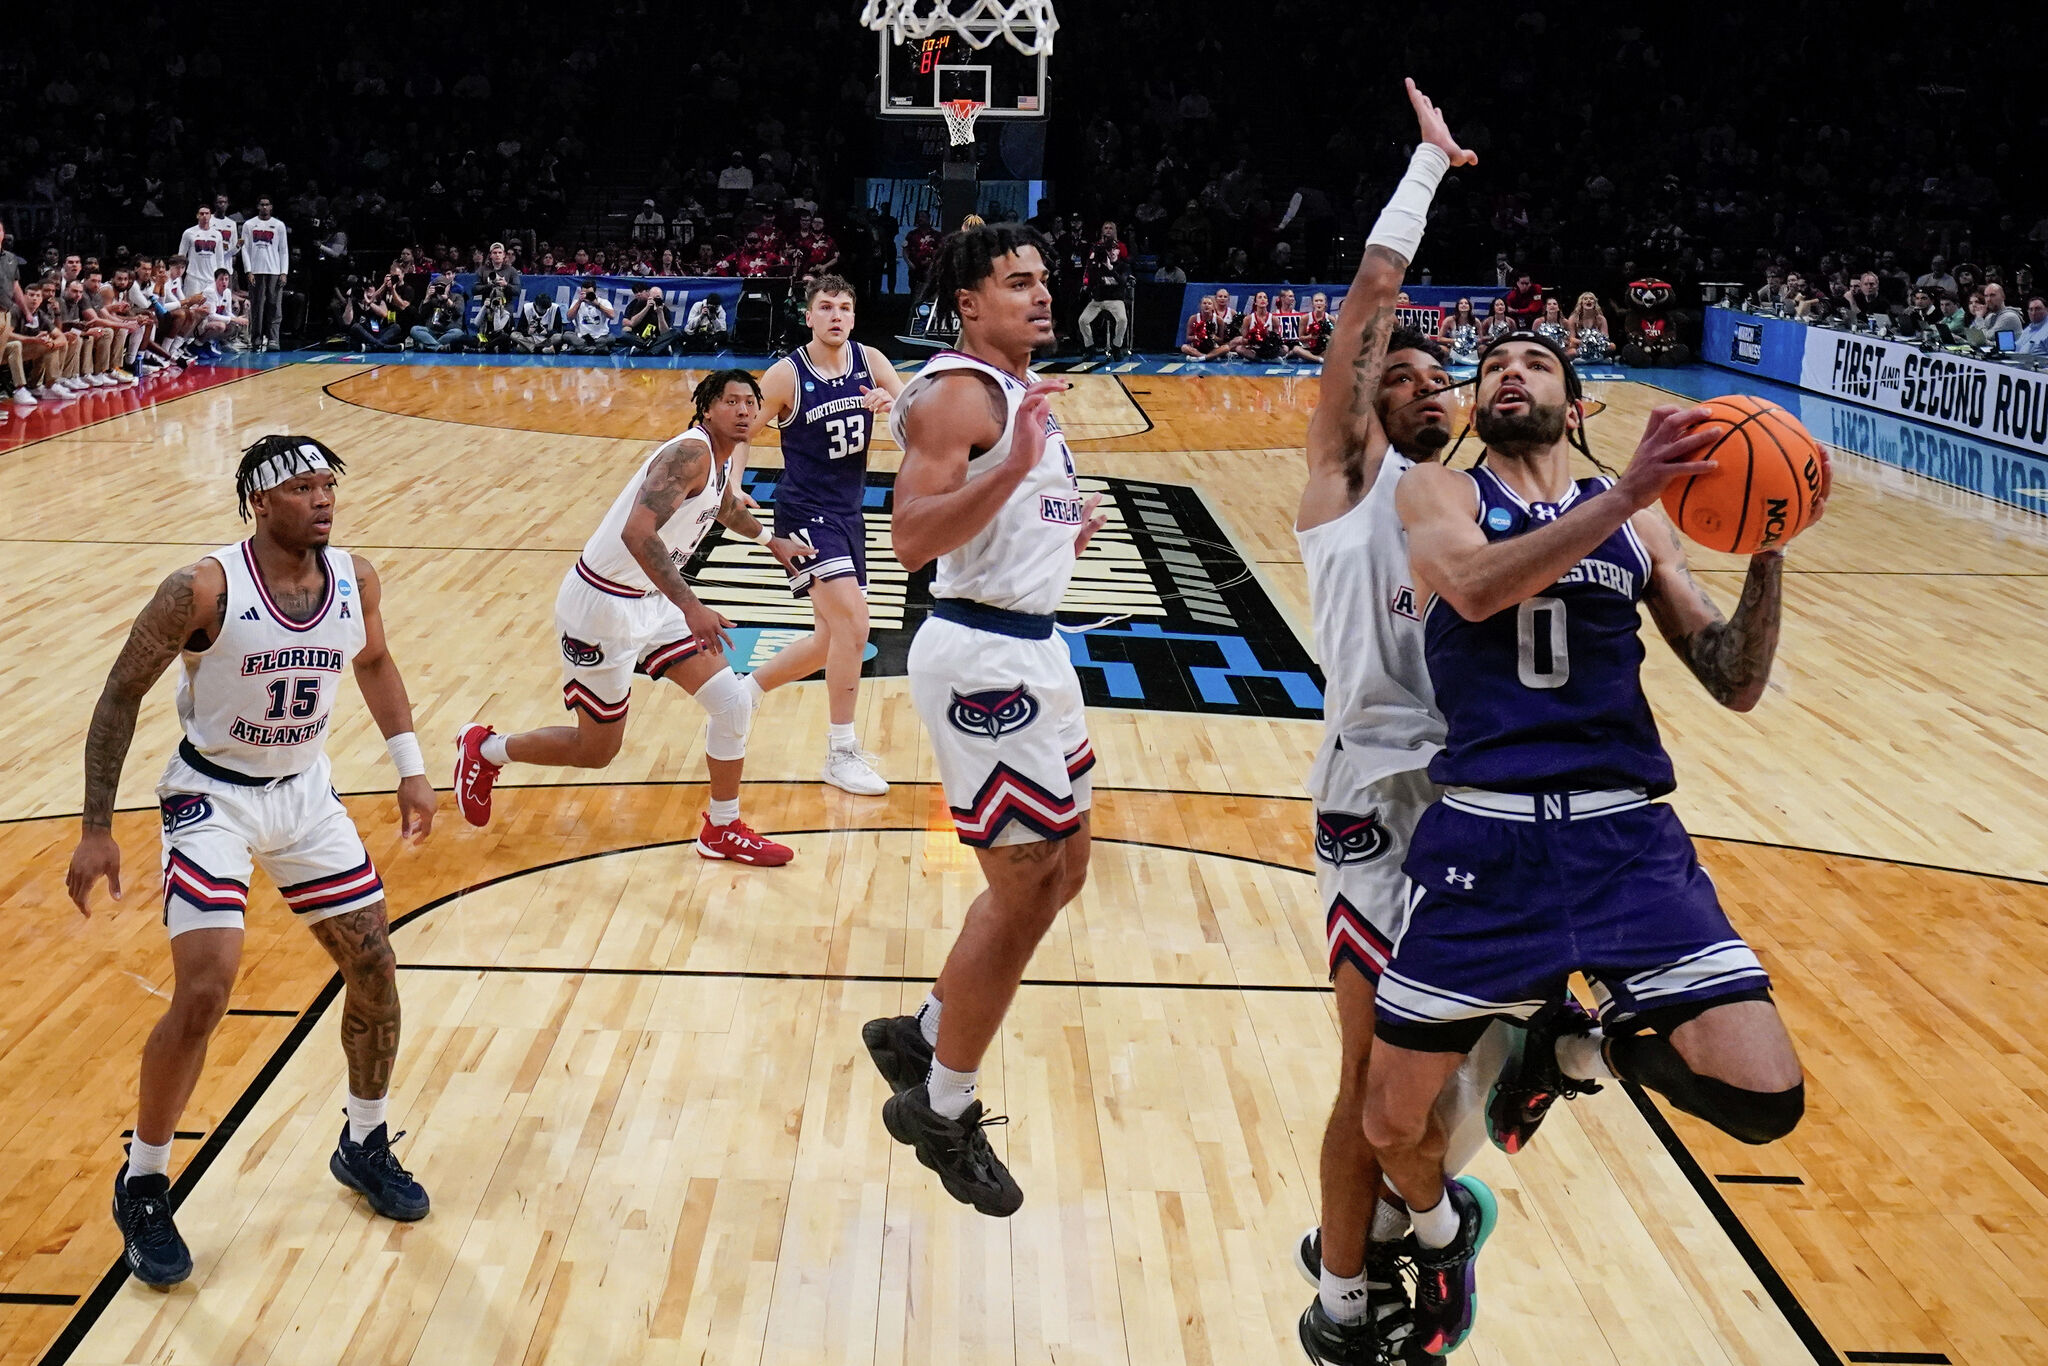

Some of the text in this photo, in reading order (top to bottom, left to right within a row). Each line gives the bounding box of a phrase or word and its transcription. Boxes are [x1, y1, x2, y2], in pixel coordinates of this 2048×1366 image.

[1832, 338, 1886, 400] FIRST
[1880, 365, 1900, 390] AND
[1900, 353, 1987, 429] SECOND
[825, 414, 865, 460] 33
[1043, 498, 1082, 523] ATLA
[1760, 498, 1789, 549] NCA
[243, 648, 343, 675] FLORIDA
[1517, 597, 1570, 689] 0
[266, 676, 320, 721] 15
[231, 713, 328, 745] ATLANTIC
[1543, 793, 1563, 821] N
